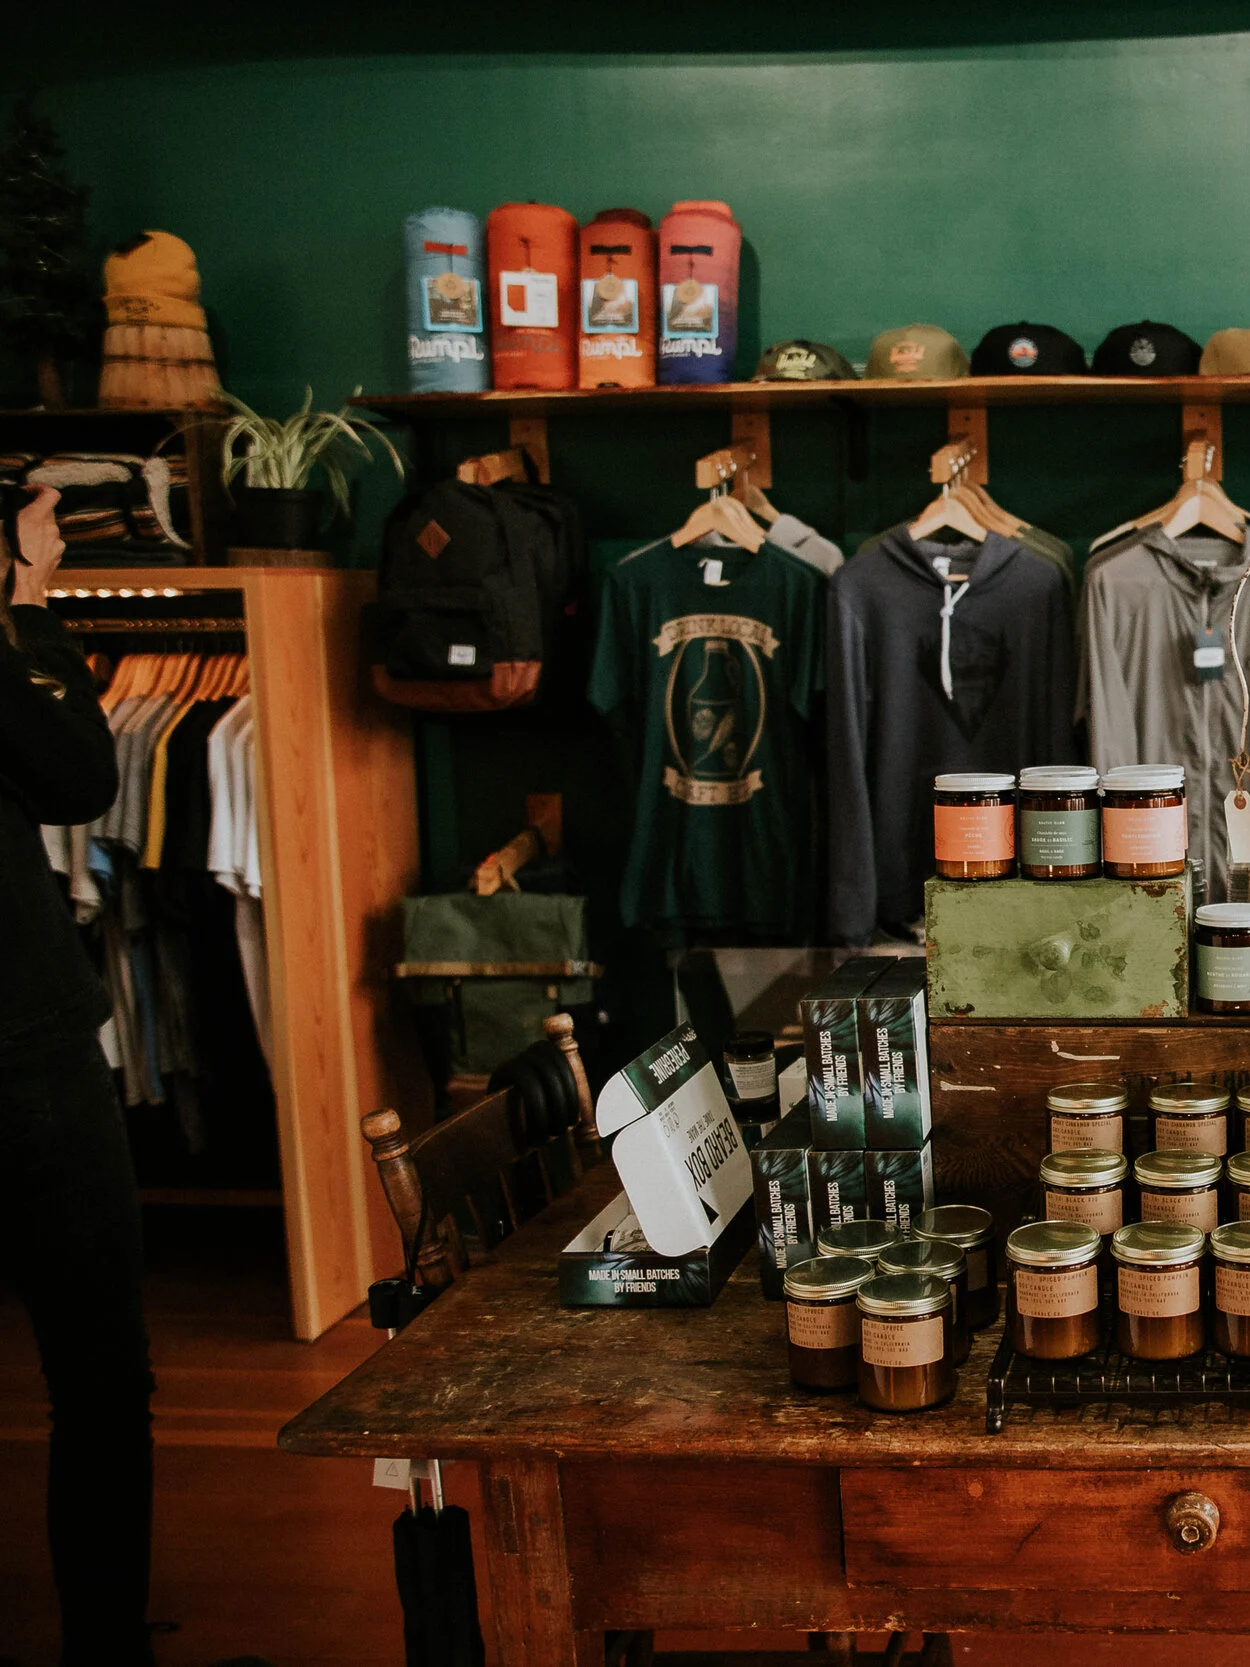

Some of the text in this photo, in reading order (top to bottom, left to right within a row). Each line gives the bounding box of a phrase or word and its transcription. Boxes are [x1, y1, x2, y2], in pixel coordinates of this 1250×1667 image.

[581, 338, 642, 359] Rumpl
[820, 1031, 833, 1064] BATCHES
[877, 1027, 889, 1062] BATCHES
[649, 1042, 691, 1085] PEREGRINE
[835, 1055, 849, 1097] BY FRIENDS
[879, 1062, 892, 1089] SMALL
[892, 1051, 906, 1094] BY FRIENDS
[822, 1065, 835, 1091] SMALL
[825, 1098, 838, 1121] MADE
[882, 1095, 894, 1119] MADE
[684, 1117, 738, 1192] BEARD BOX
[769, 1180, 782, 1213] BATCHES
[827, 1182, 840, 1215] BATCHES
[884, 1180, 897, 1213] BATCHES
[772, 1214, 784, 1239] SMALL
[784, 1204, 798, 1245] BY FRIENDS
[843, 1205, 854, 1223] ENDS
[775, 1245, 788, 1269] MADE
[588, 1269, 680, 1281] MADE IN SMALL BATCHES
[614, 1282, 656, 1293] BY FRIENDS
[1063, 1271, 1088, 1280] PUMPKIN
[1130, 1282, 1153, 1291] CANDLE
[1227, 1281, 1249, 1289] CANDLE
[797, 1315, 816, 1323] CANDLE
